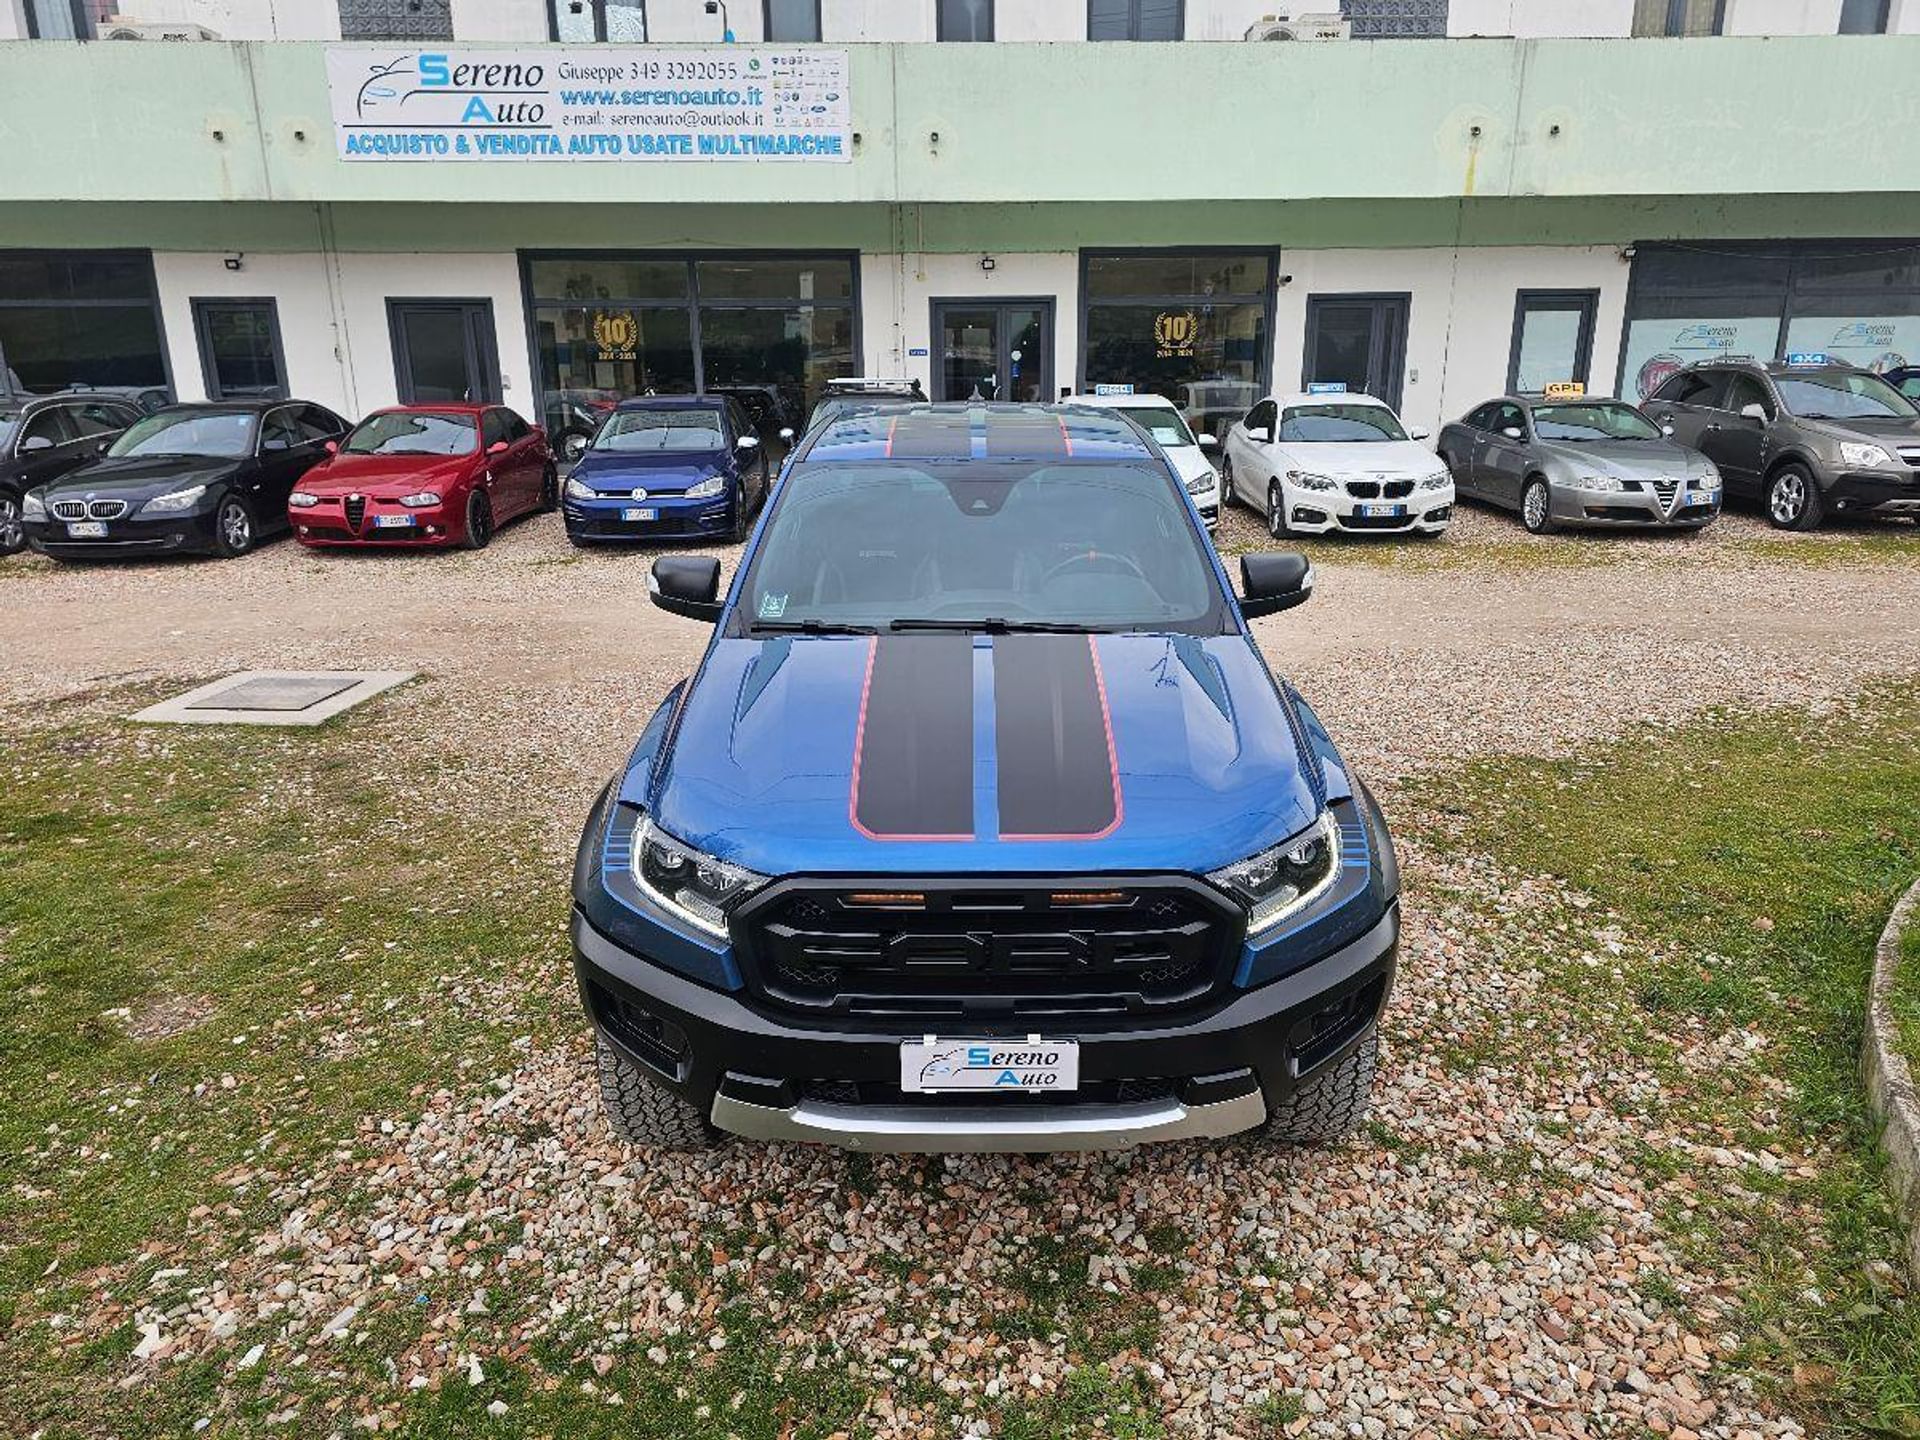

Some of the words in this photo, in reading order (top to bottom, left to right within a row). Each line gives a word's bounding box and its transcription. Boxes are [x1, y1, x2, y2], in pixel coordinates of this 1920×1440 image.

[419, 54, 544, 87] Sereno
[558, 62, 624, 84] Giuseppe
[630, 62, 660, 80] 349
[667, 62, 738, 80] 3292055
[560, 86, 764, 106] www.serenoauto.it
[461, 96, 544, 123] Auto
[562, 110, 605, 126] e-mail:
[610, 110, 764, 128] serenoauto@outlook.it
[346, 134, 449, 155] ACQUISTO
[455, 135, 471, 154] &
[474, 134, 564, 155] VENDITA
[568, 134, 623, 155] AUTO
[628, 134, 693, 155] USATE
[698, 134, 843, 155] MULTIMARCHE
[1549, 384, 1581, 392] GPL
[967, 1047, 1059, 1066] Sereno
[995, 1070, 1058, 1086] Auto
